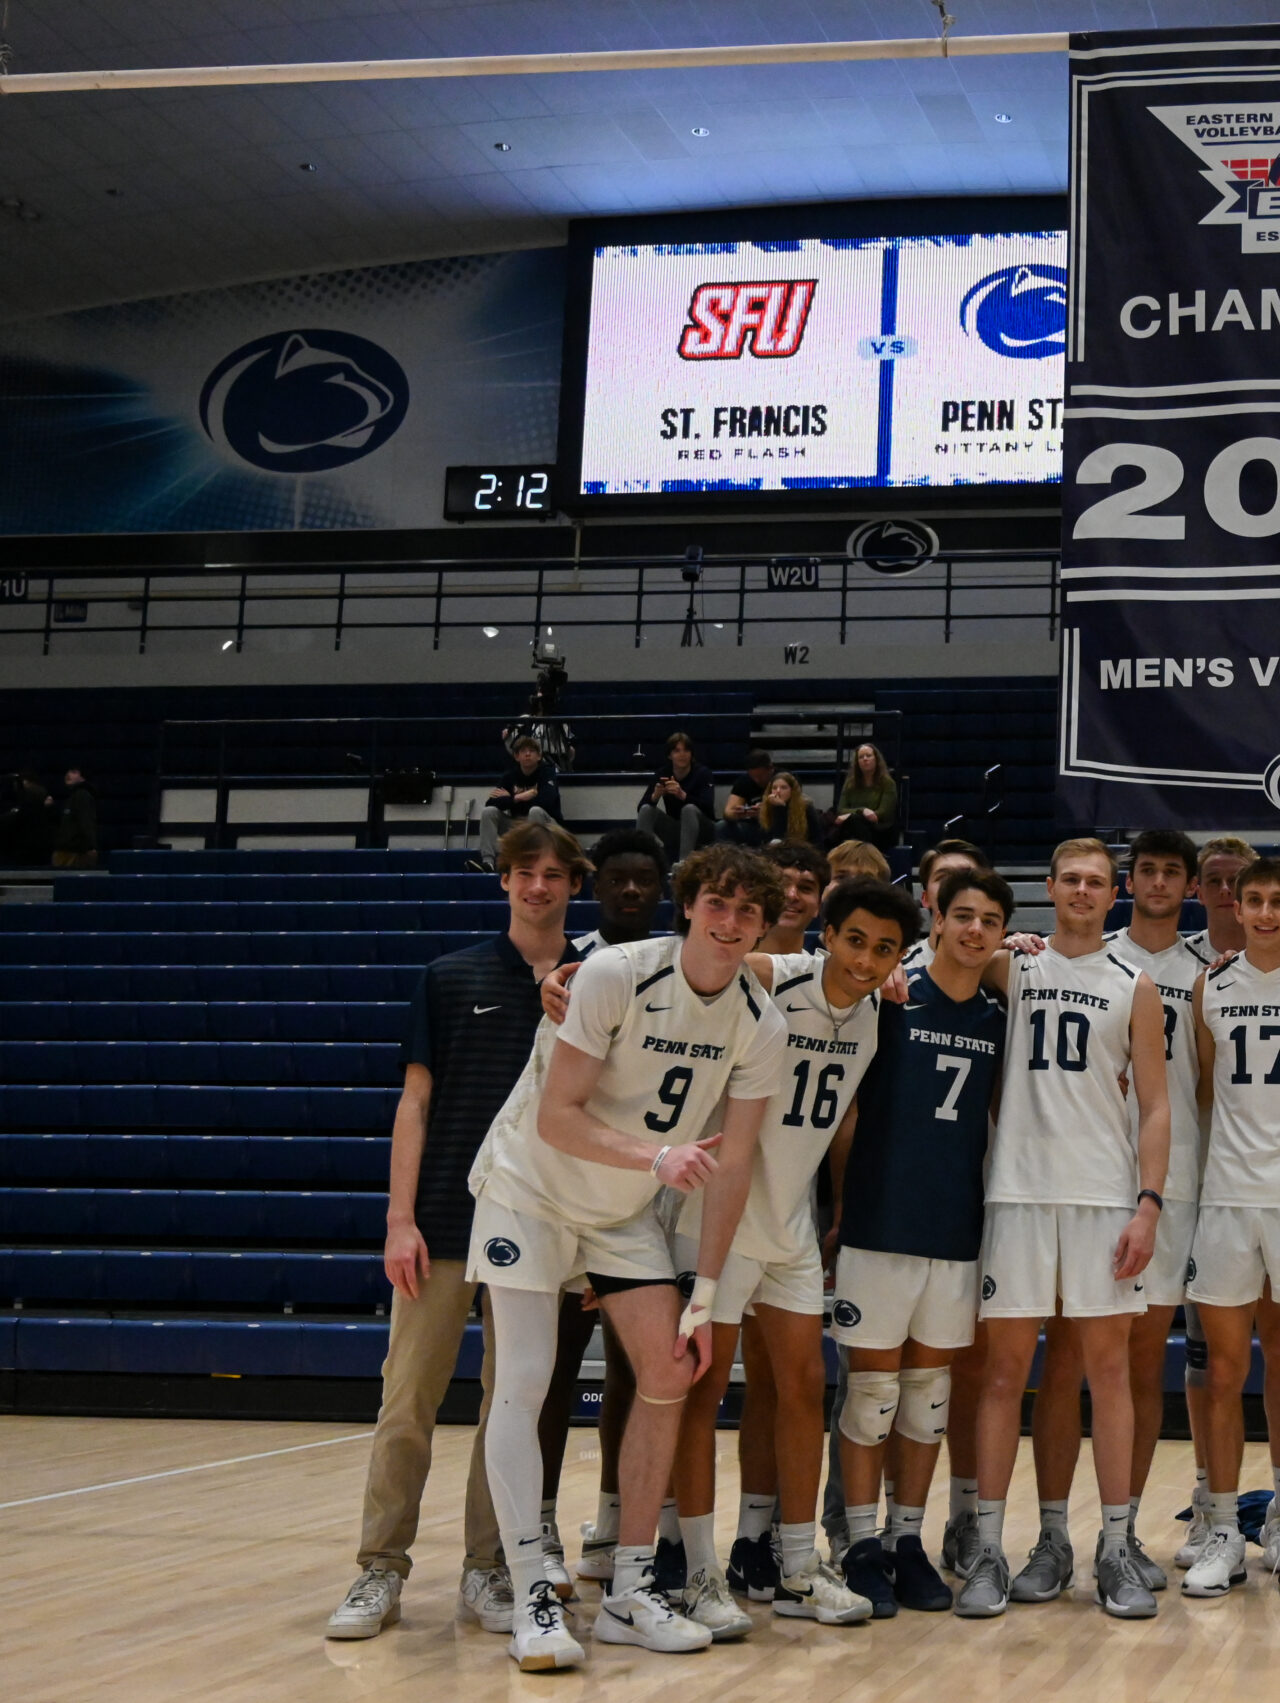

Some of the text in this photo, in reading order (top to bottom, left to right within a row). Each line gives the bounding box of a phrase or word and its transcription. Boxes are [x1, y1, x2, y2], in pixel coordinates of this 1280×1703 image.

[1186, 112, 1273, 126] EASTERN
[677, 278, 818, 360] SFU
[870, 340, 905, 355] VS
[660, 404, 828, 440] ST. FRANCIS
[941, 398, 1064, 432] PENN ST
[678, 445, 807, 461] RED FLASH
[935, 439, 1064, 455] NITTANY L
[474, 473, 548, 510] 2:12
[771, 565, 817, 587] W2U
[784, 646, 809, 664] W2
[1099, 656, 1234, 690] MEN'S
[1021, 988, 1110, 1011] PENN STATE
[1156, 984, 1193, 1003] TATE
[1220, 1006, 1259, 1018] PENN
[642, 1035, 726, 1061] PENN SAT
[787, 1033, 859, 1055] PENN STATE
[909, 1027, 996, 1055] PENN STATE
[1028, 1009, 1091, 1072] 10
[643, 1065, 694, 1134] 9
[782, 1059, 845, 1129] 16
[934, 1053, 972, 1121] 7
